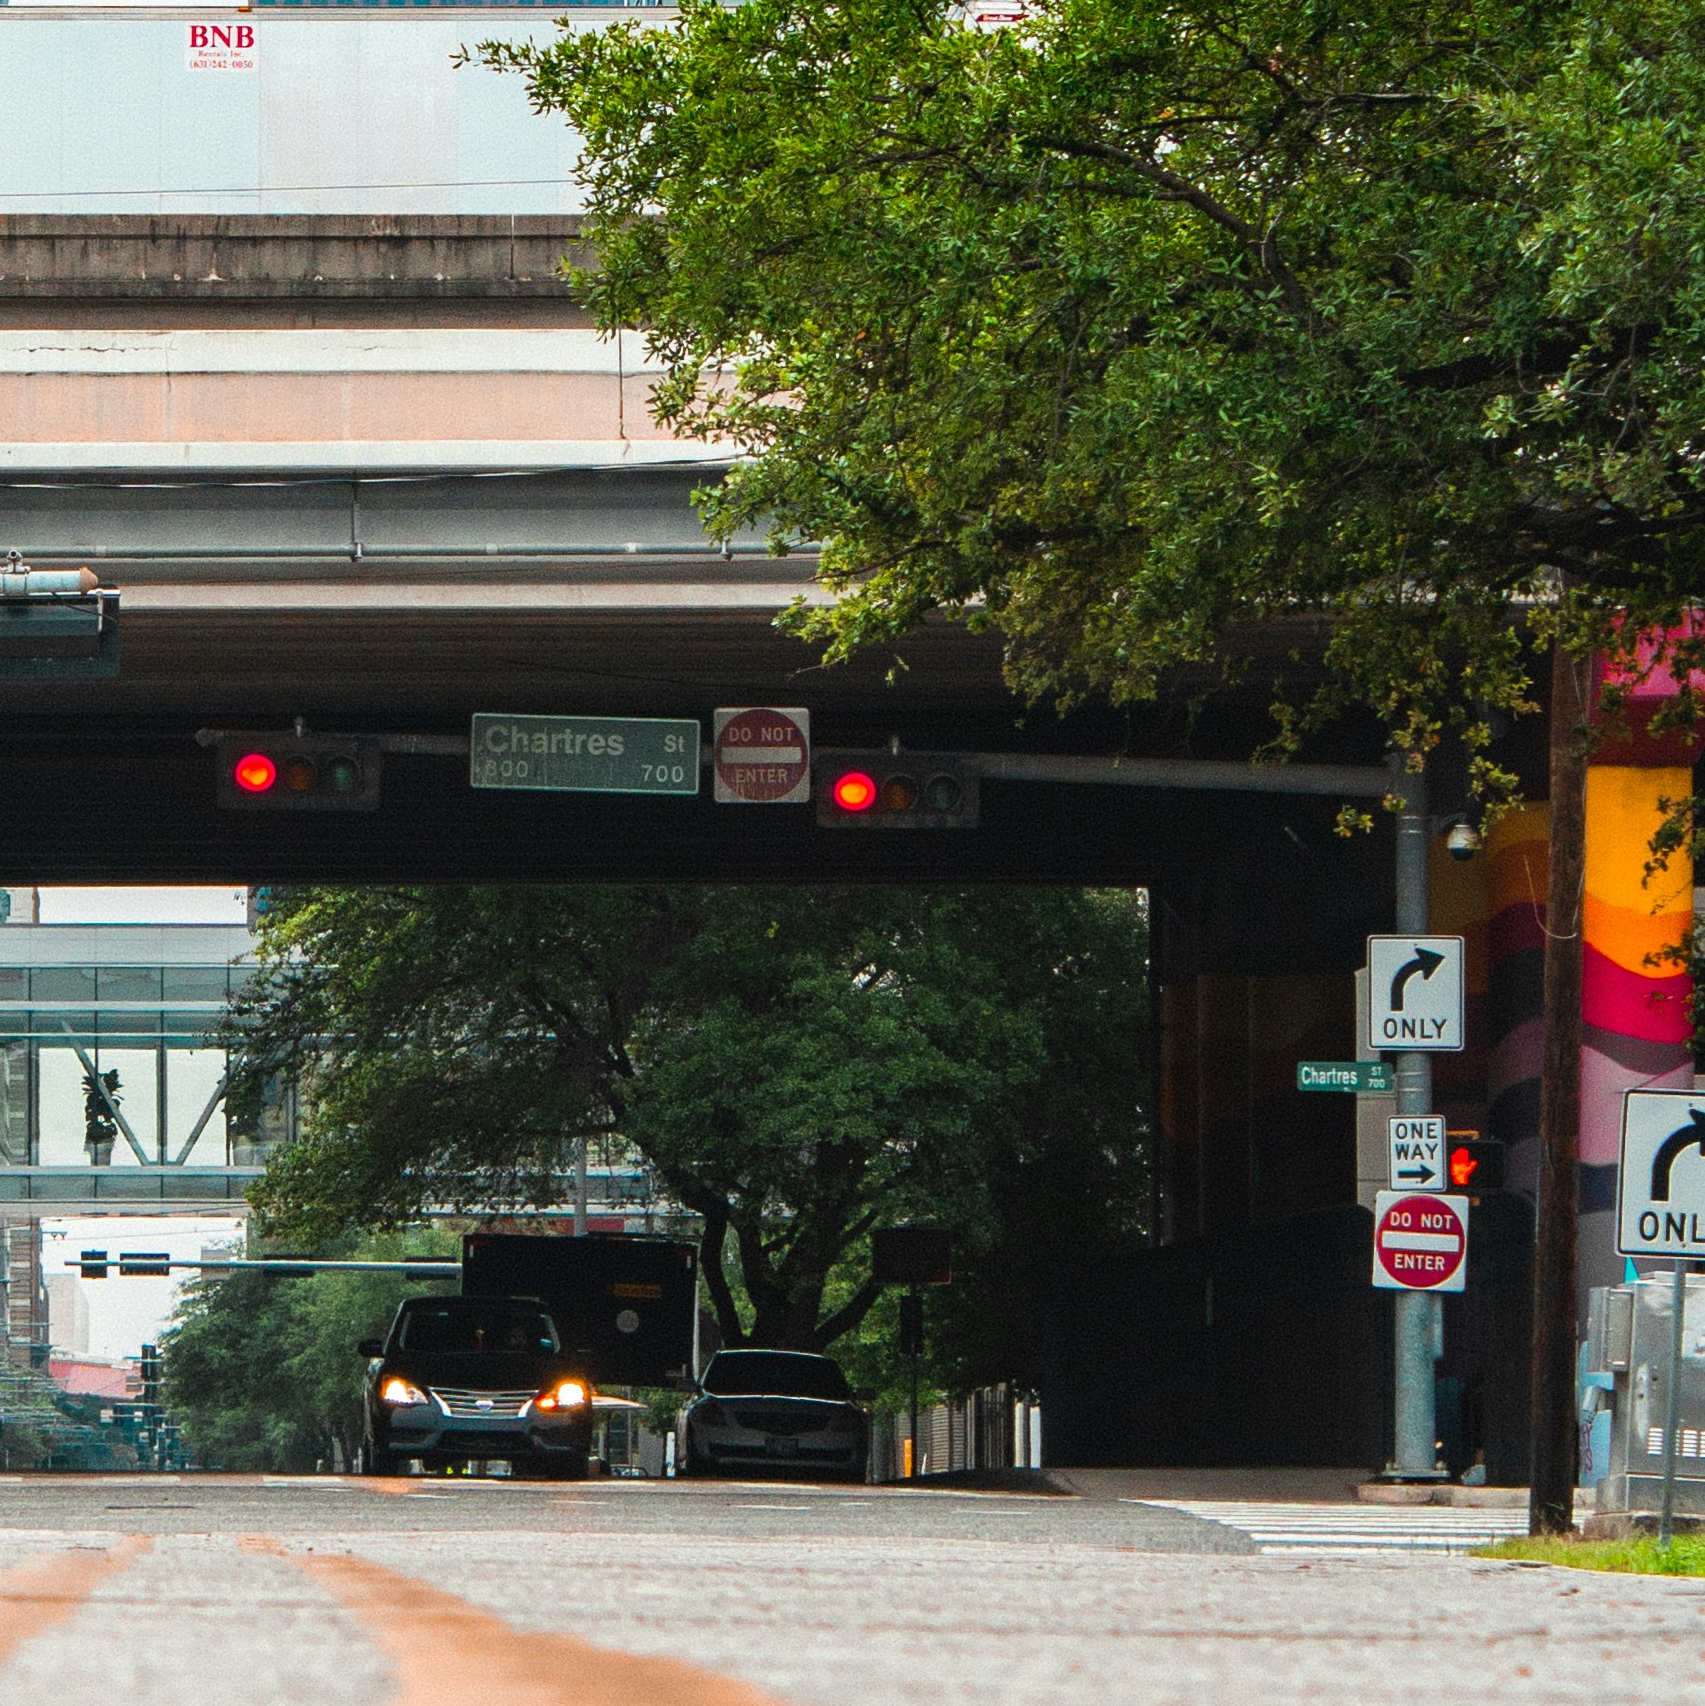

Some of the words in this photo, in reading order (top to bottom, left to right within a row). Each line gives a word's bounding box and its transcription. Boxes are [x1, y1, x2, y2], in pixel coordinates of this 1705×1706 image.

[189, 25, 255, 48] BNB
[485, 725, 625, 756] Chartres
[664, 735, 685, 753] St
[729, 727, 752, 742] DO
[761, 727, 794, 742] NOT
[641, 765, 684, 783] 700
[735, 769, 788, 784] ENTER
[1383, 1018, 1447, 1039] ONLY
[1301, 1066, 1358, 1084] Chartres
[1371, 1066, 1382, 1076] ST
[1368, 1078, 1385, 1088] 700
[1395, 1123, 1438, 1139] ONE
[1395, 1143, 1439, 1160] WAY
[1390, 1212, 1412, 1227] DO
[1421, 1213, 1453, 1229] NOT
[1639, 1210, 1705, 1243] ONL
[1394, 1253, 1445, 1271] ENTER
